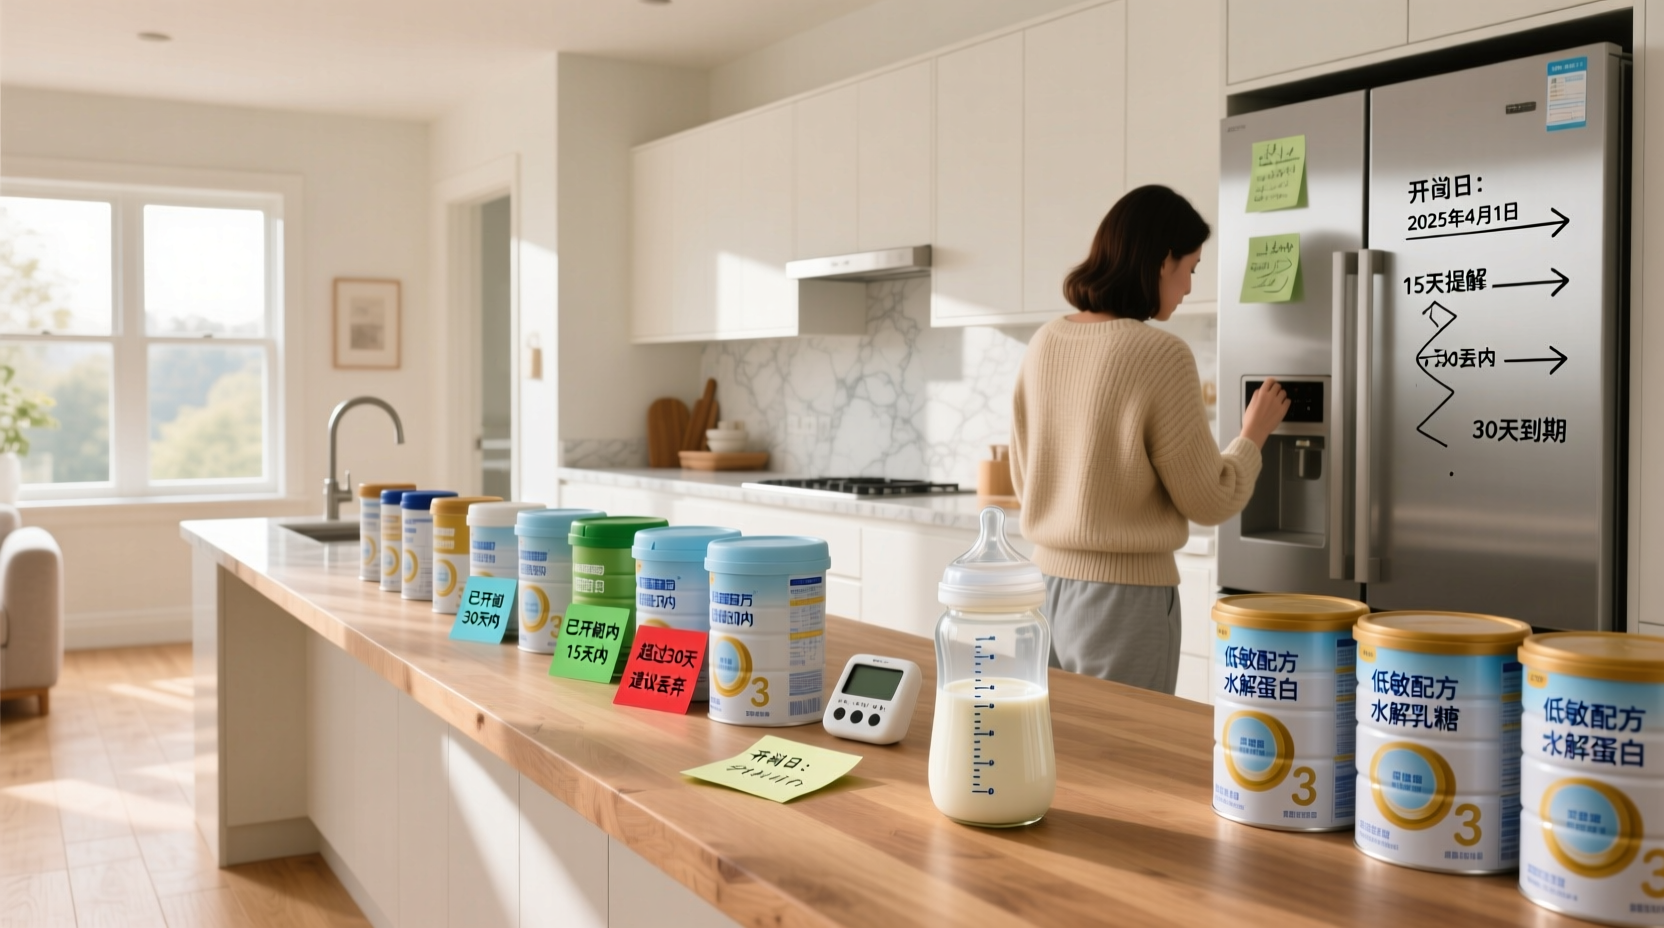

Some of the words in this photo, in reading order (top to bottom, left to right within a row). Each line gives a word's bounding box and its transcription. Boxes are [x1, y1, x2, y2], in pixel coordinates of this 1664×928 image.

[1407, 202, 1518, 231] 2025年4月1日
[1472, 417, 1567, 443] 30天到期
[462, 610, 500, 629] 30天内
[567, 644, 608, 665] 15天内
[636, 643, 698, 668] 超过30天
[1225, 645, 1298, 673] 低敏配方
[751, 676, 769, 707] 3
[1224, 673, 1298, 701] 水解蛋白
[1371, 668, 1459, 700] 低敏配方
[1371, 699, 1460, 731] 水解乳糖
[1543, 697, 1646, 732] 低敏配方
[1542, 730, 1645, 767] 水解蛋白
[1291, 766, 1317, 806] 3
[1453, 803, 1482, 847] 3
